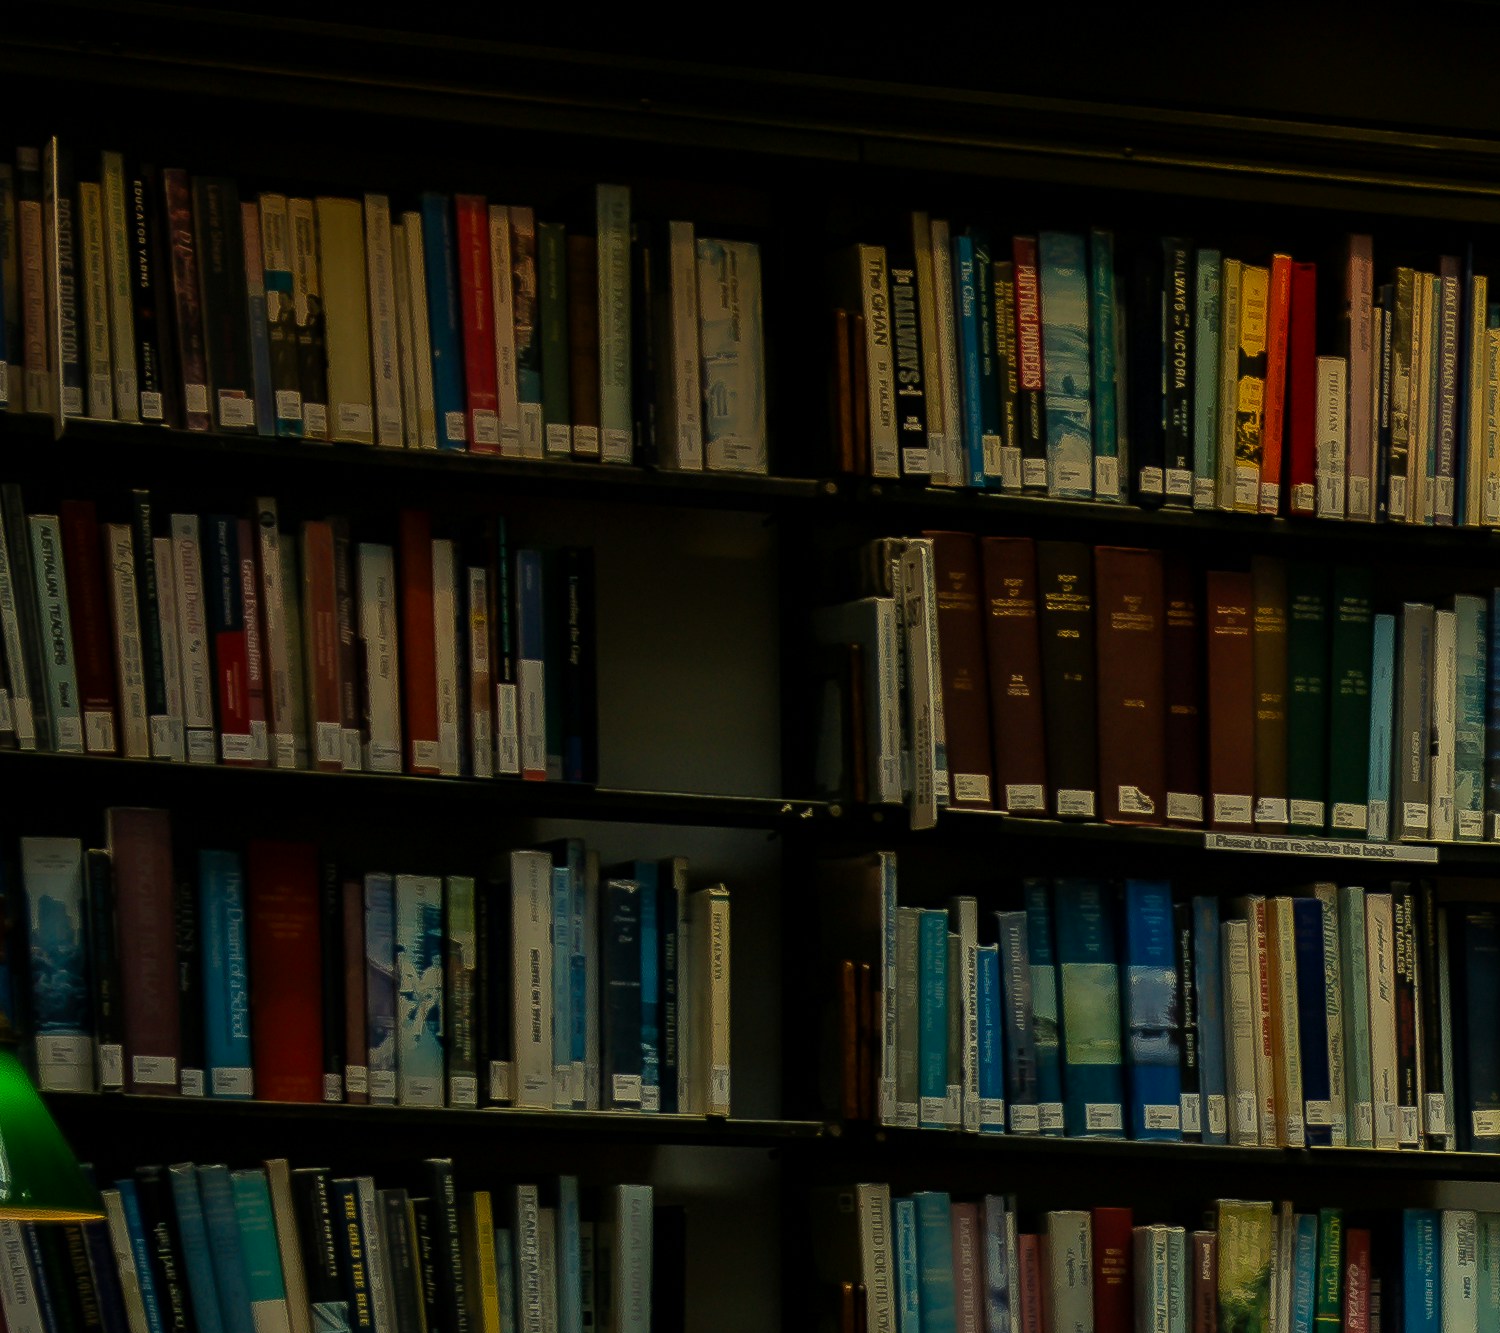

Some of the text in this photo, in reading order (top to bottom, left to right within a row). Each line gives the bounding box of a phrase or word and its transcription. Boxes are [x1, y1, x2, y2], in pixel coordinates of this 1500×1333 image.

[59, 198, 77, 363] POSITIVE EDUCATION
[133, 180, 148, 288] EDUCATOR YARNS
[869, 258, 887, 346] The GHAN
[894, 284, 920, 383] RAILWAYS
[1020, 265, 1042, 388] PUFFING PIONEERS
[41, 525, 67, 665] AUSTRALIAN TEACHERS
[242, 560, 256, 596] Great
[344, 1192, 369, 1327] THE GOLD THE BLUE
